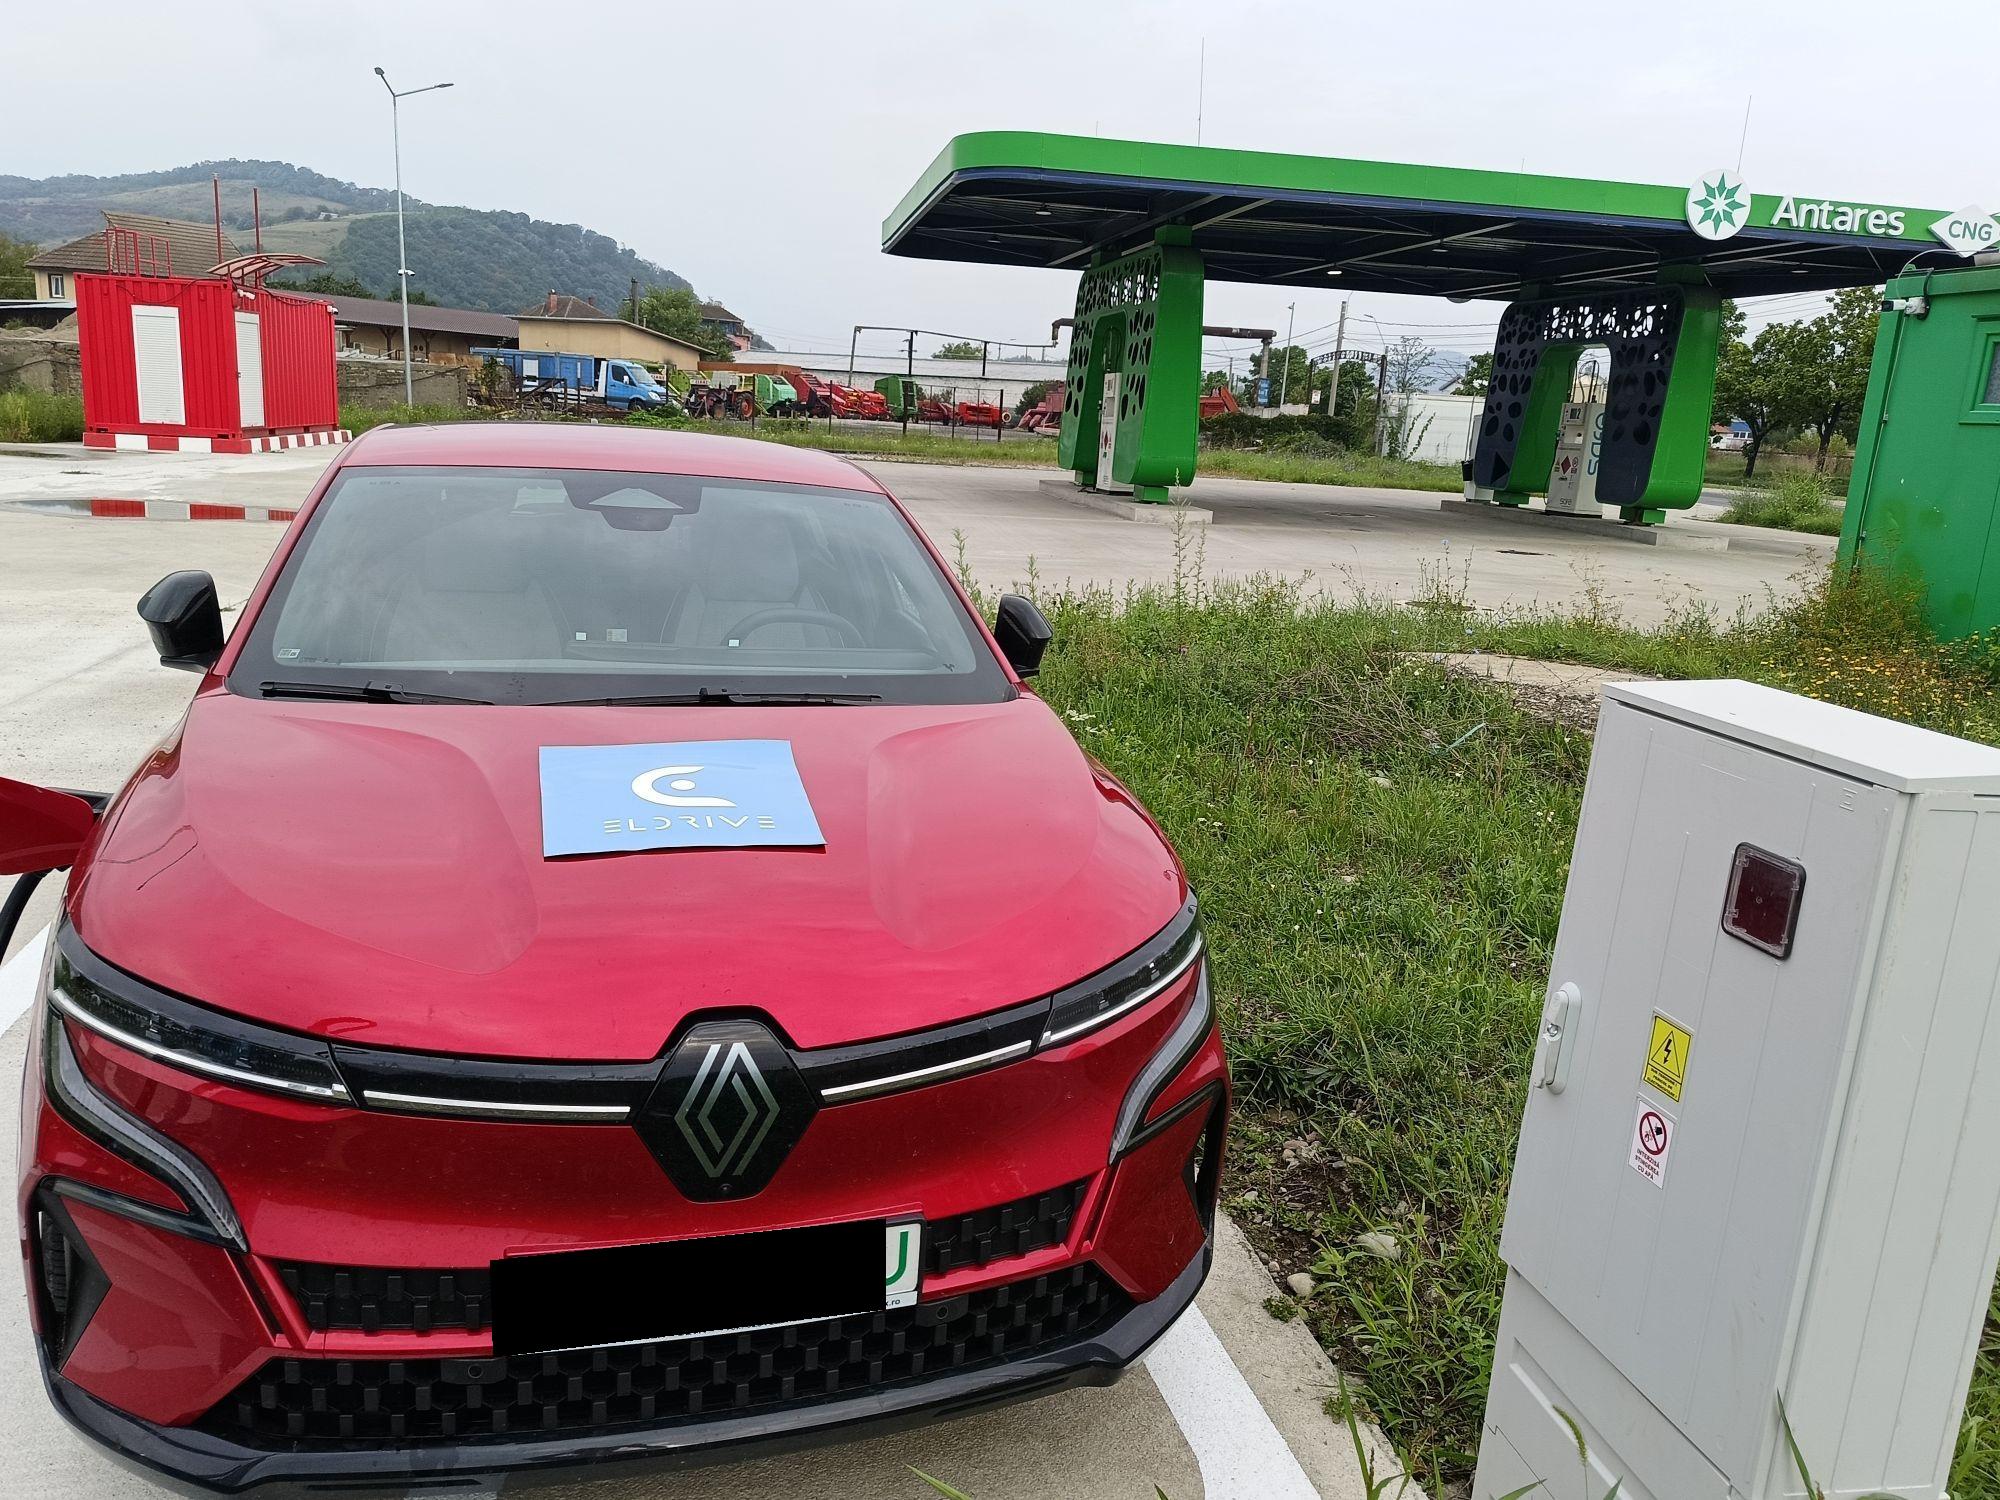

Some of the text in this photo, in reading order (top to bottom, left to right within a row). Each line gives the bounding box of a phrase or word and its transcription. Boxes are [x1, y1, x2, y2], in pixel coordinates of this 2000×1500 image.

[1770, 195, 1906, 236] Antares
[1948, 220, 1993, 242] CNG
[604, 815, 776, 834] ELDRIVE
[1637, 1164, 1644, 1172] CU
